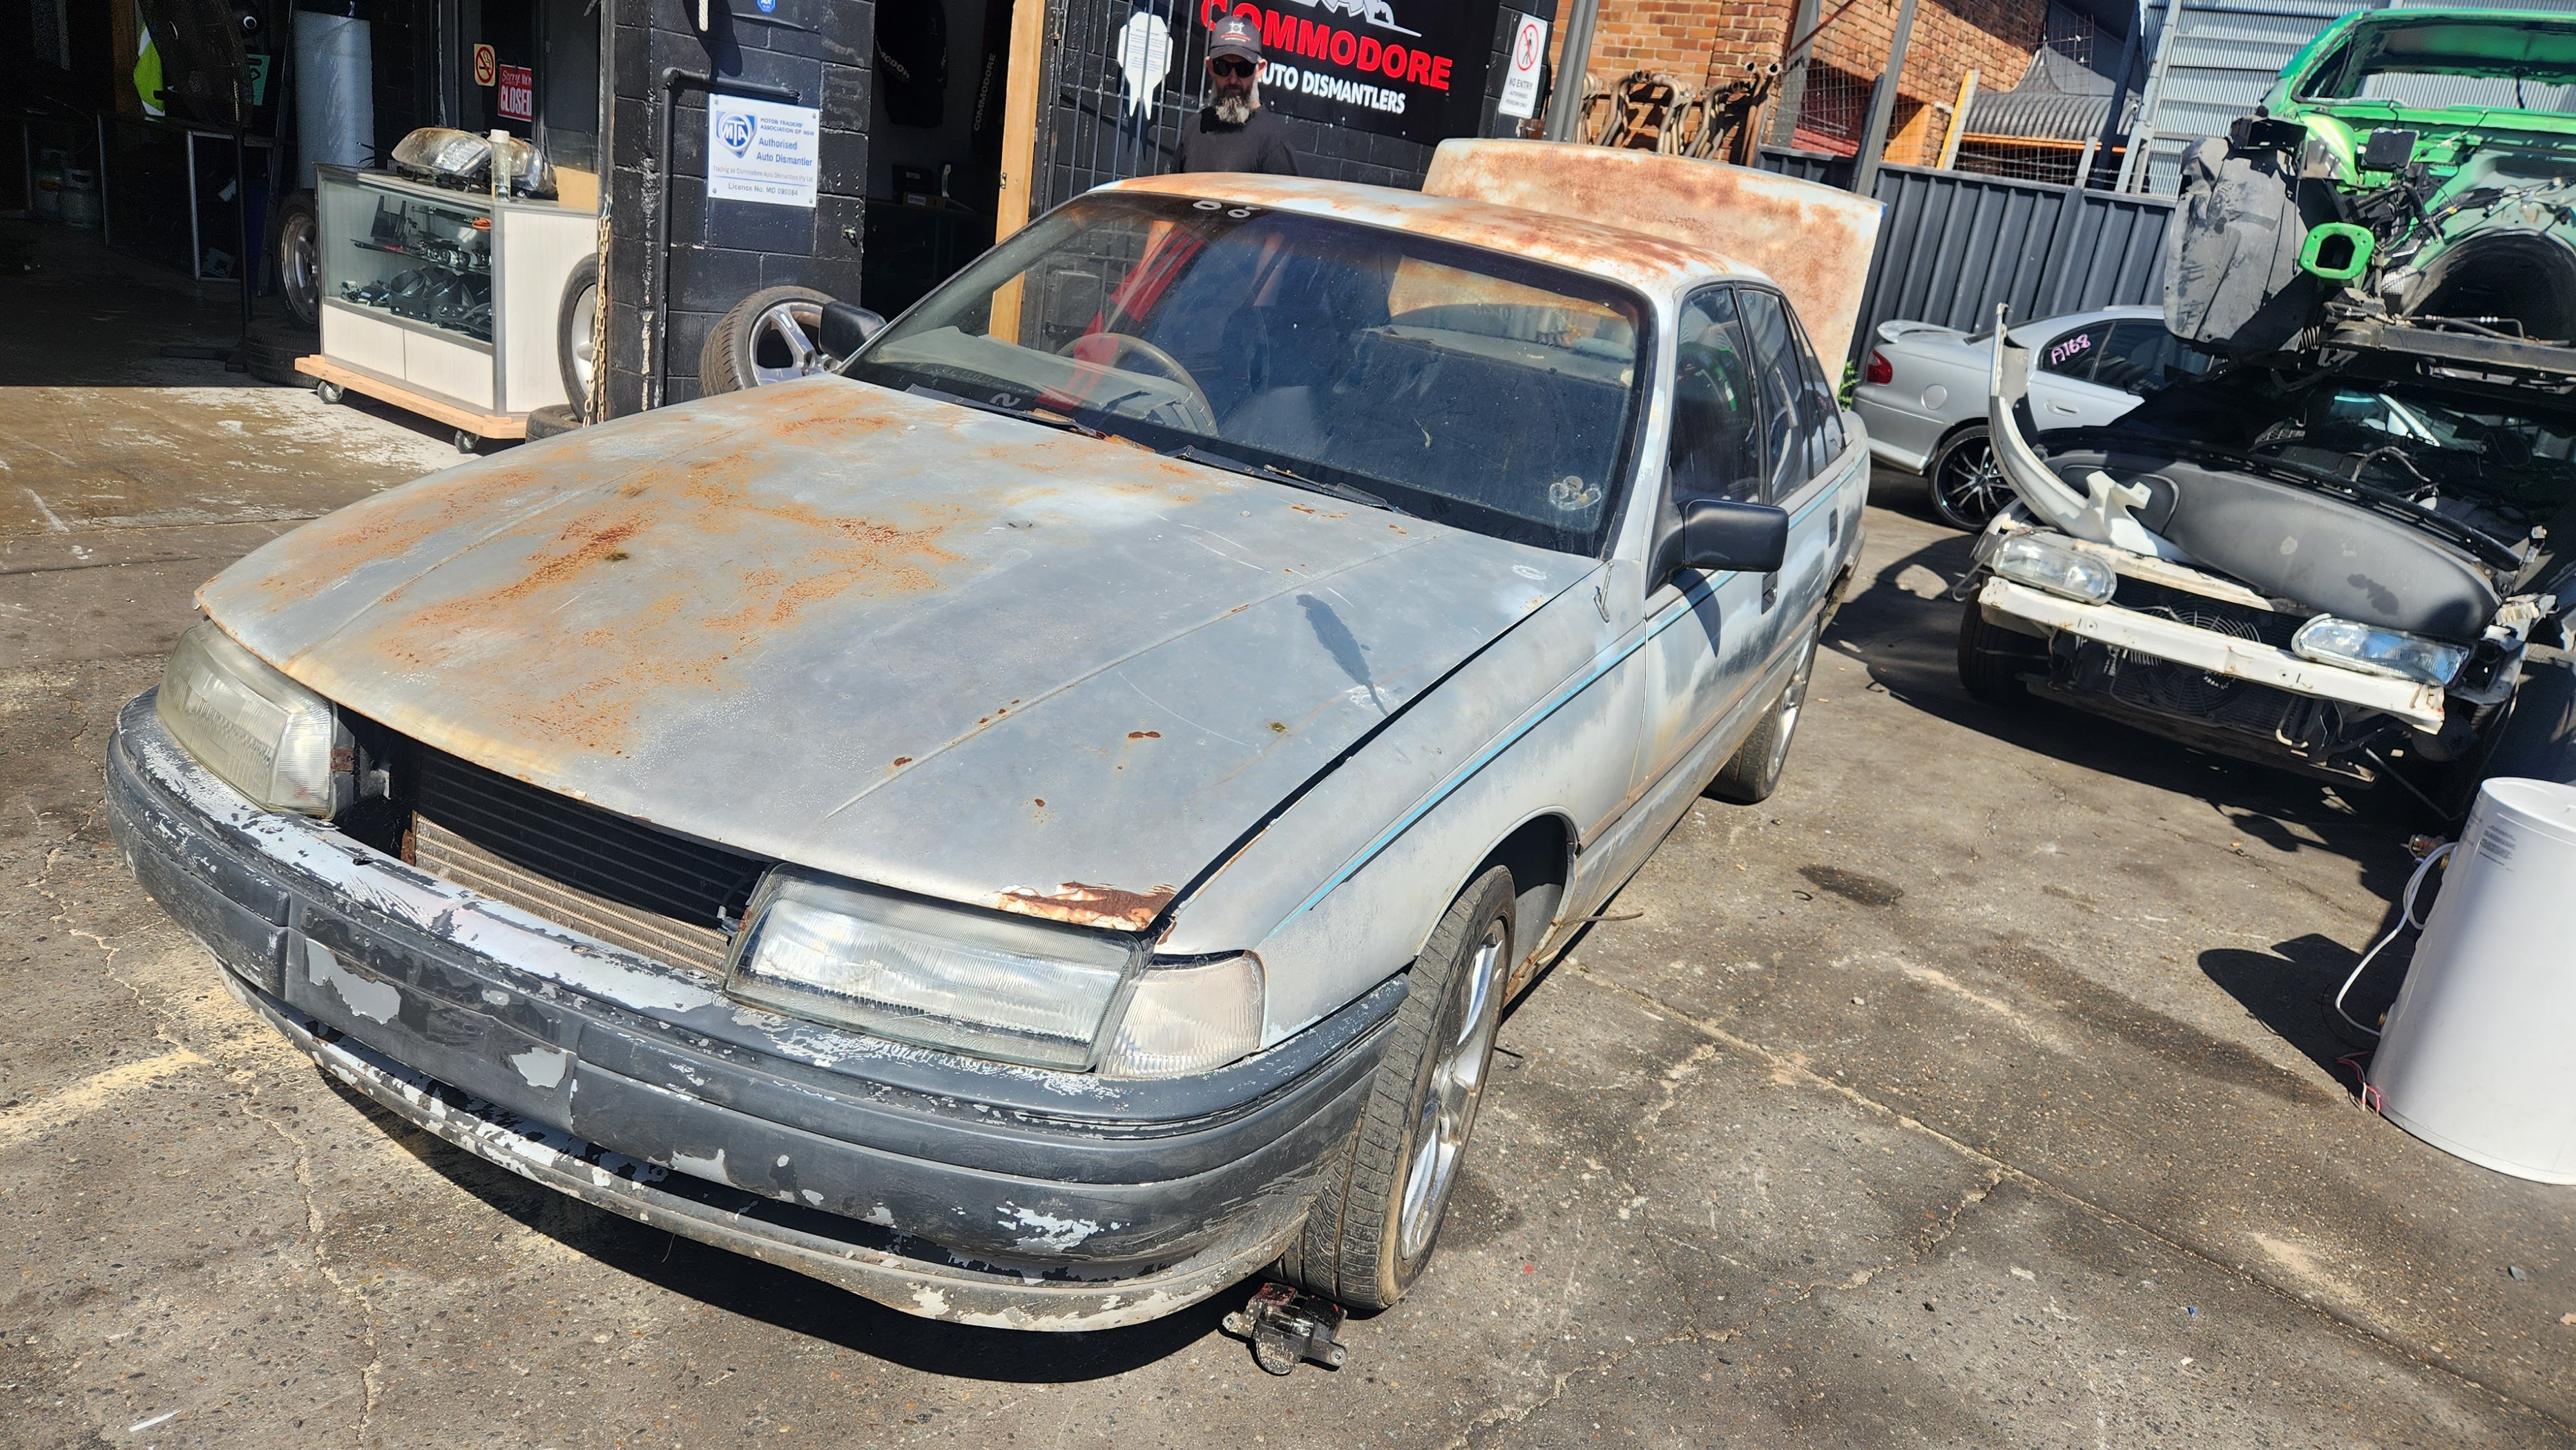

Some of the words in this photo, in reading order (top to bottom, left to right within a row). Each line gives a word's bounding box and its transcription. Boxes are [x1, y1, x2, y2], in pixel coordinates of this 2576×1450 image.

[974, 52, 996, 131] COMMODORE
[1258, 63, 1299, 90] UTO
[1302, 70, 1406, 114] DISMANTLERS
[1517, 79, 1533, 90] ENTRY
[501, 85, 532, 115] CLOSED
[722, 120, 748, 146] MTA
[760, 124, 794, 133] ASSOCIATION
[758, 137, 798, 150] Authorised
[756, 152, 773, 162] Auto
[776, 154, 813, 166] Dismantler
[728, 182, 752, 191] Licence
